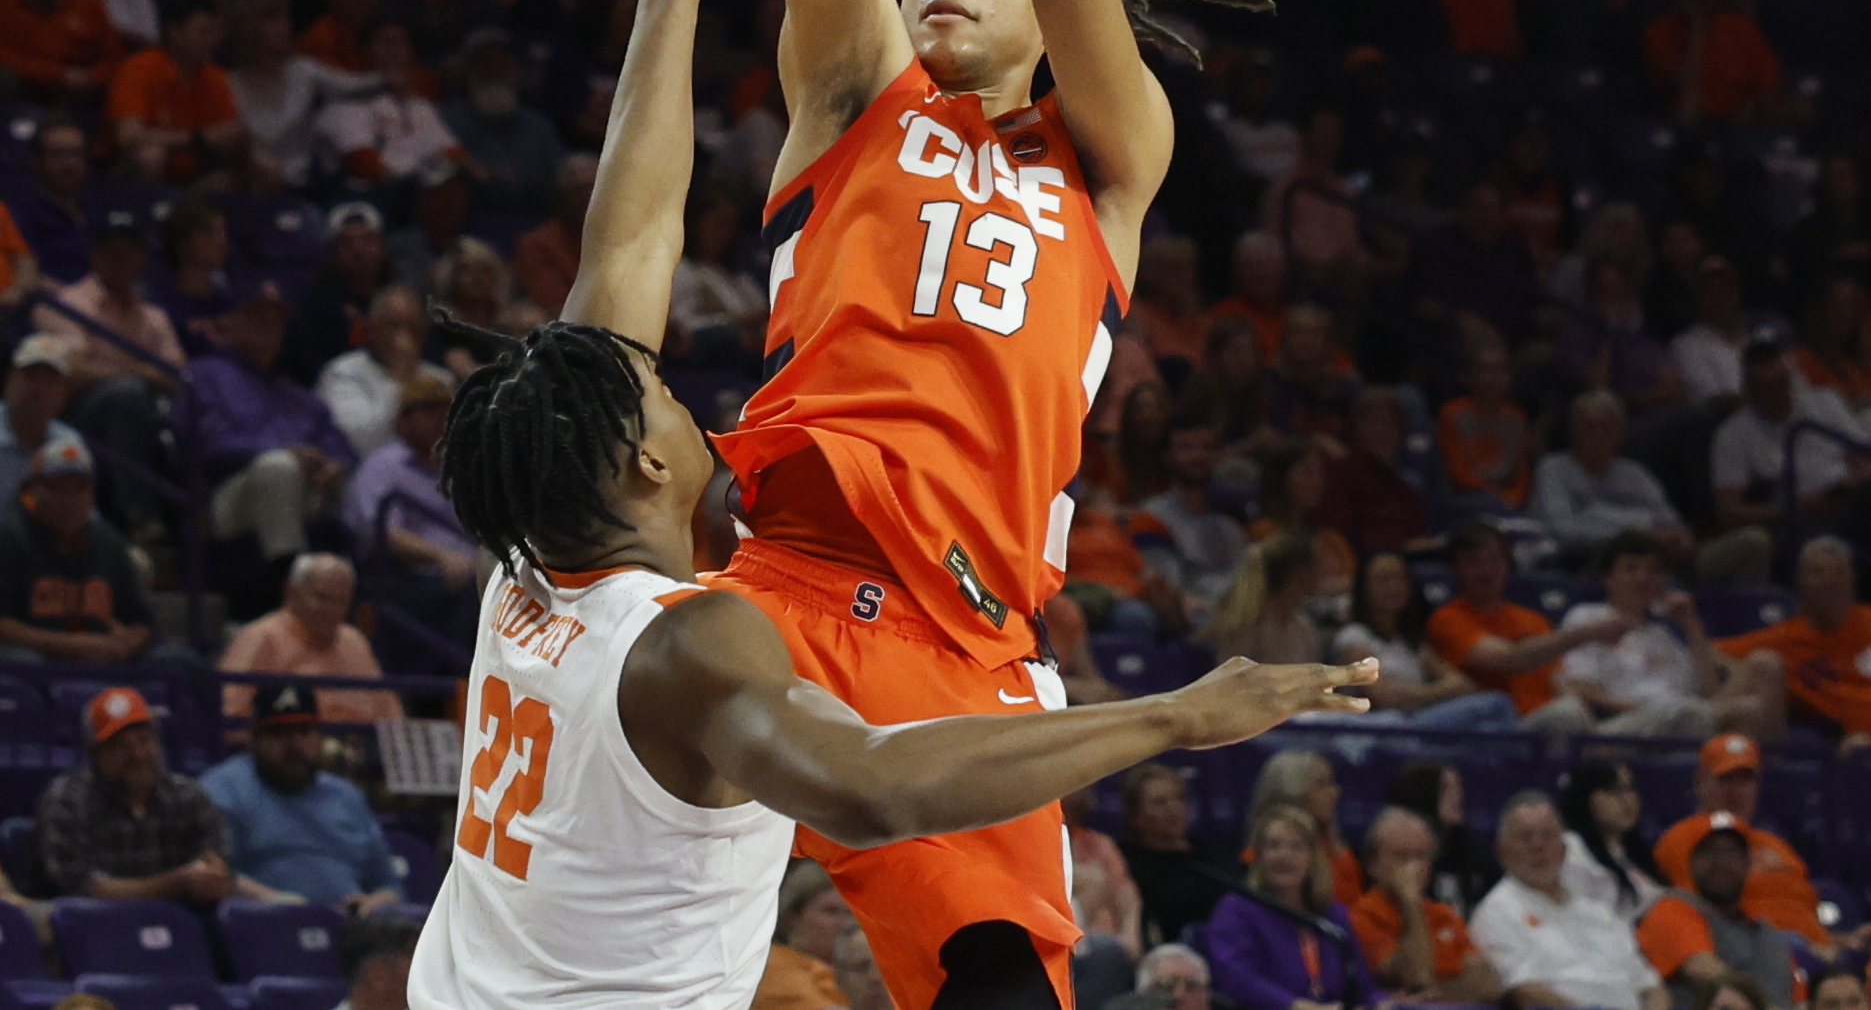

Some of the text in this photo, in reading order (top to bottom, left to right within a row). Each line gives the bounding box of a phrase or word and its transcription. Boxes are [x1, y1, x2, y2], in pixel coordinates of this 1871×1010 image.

[911, 200, 1040, 337] 13
[850, 580, 886, 623] S
[456, 674, 555, 882] 22
